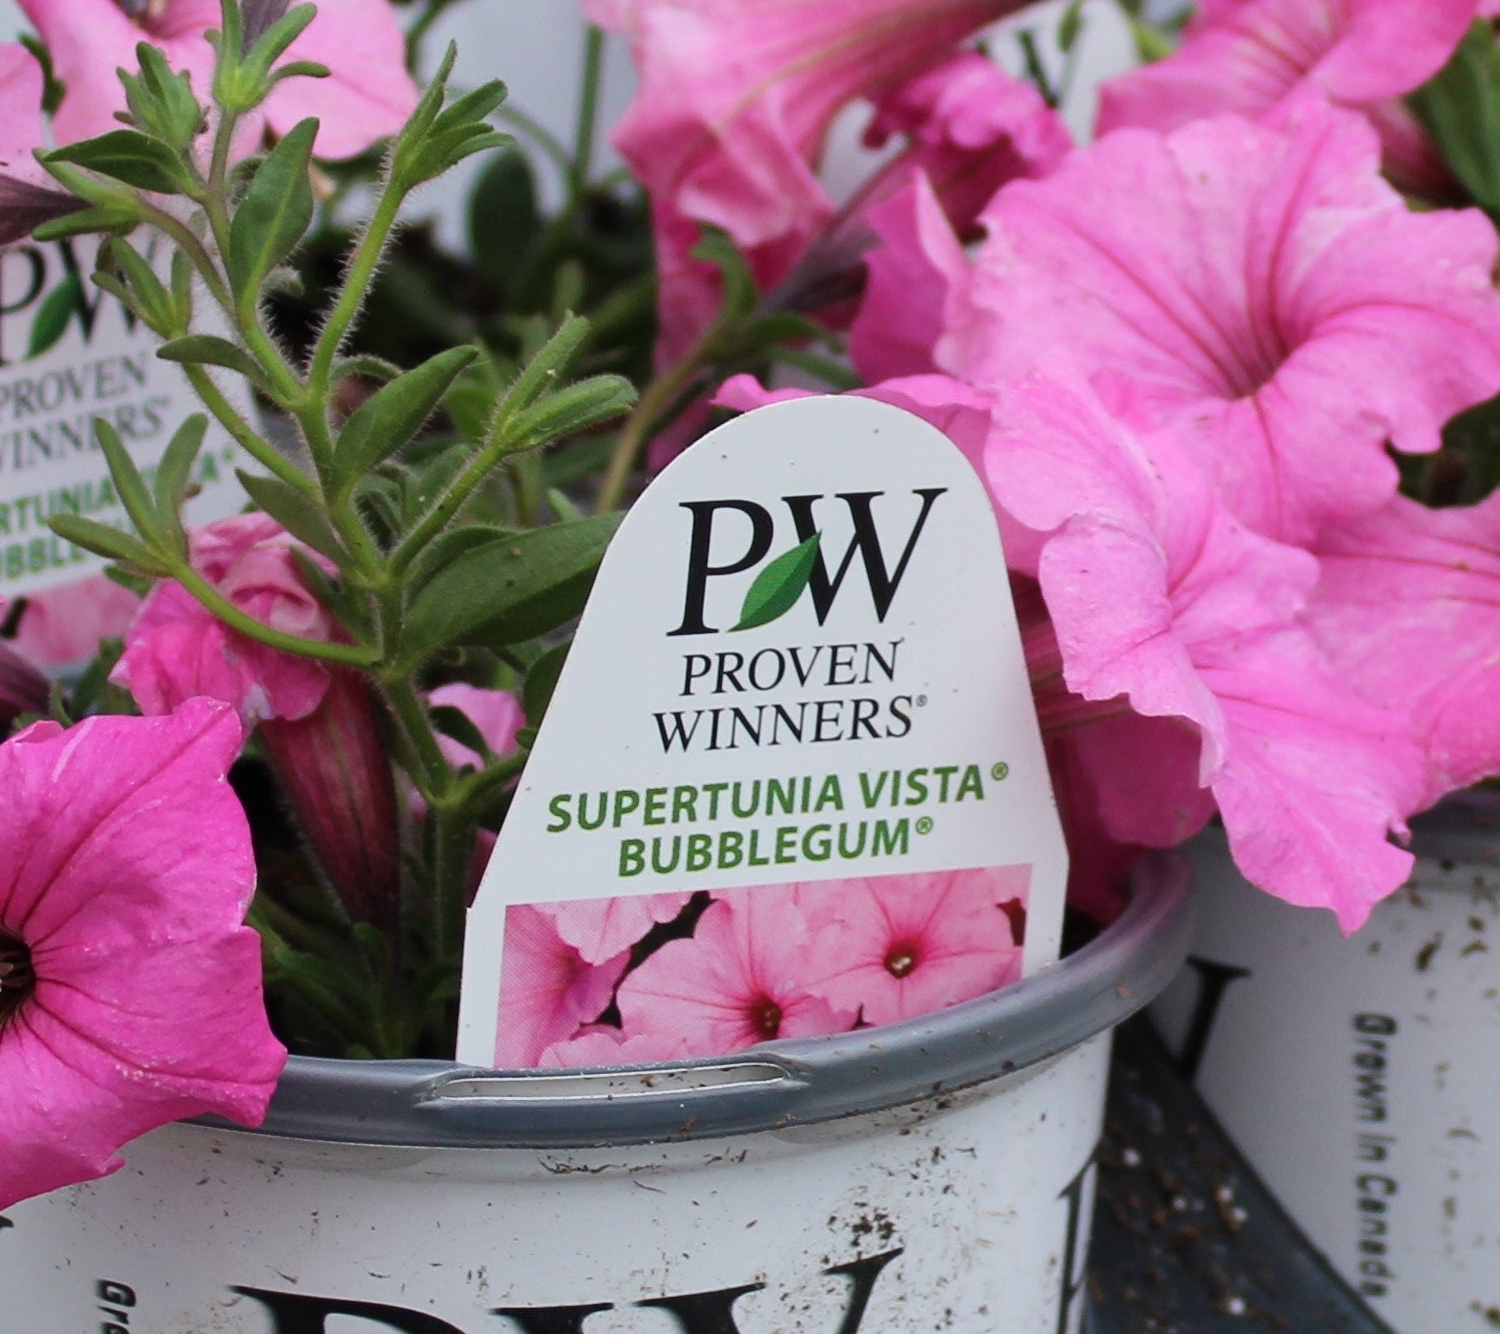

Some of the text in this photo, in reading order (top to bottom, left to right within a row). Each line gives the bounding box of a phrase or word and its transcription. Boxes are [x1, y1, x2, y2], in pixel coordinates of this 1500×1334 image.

[665, 486, 949, 638] PW
[678, 640, 902, 697] PROVEN
[545, 774, 845, 834] SUPERTUNIA
